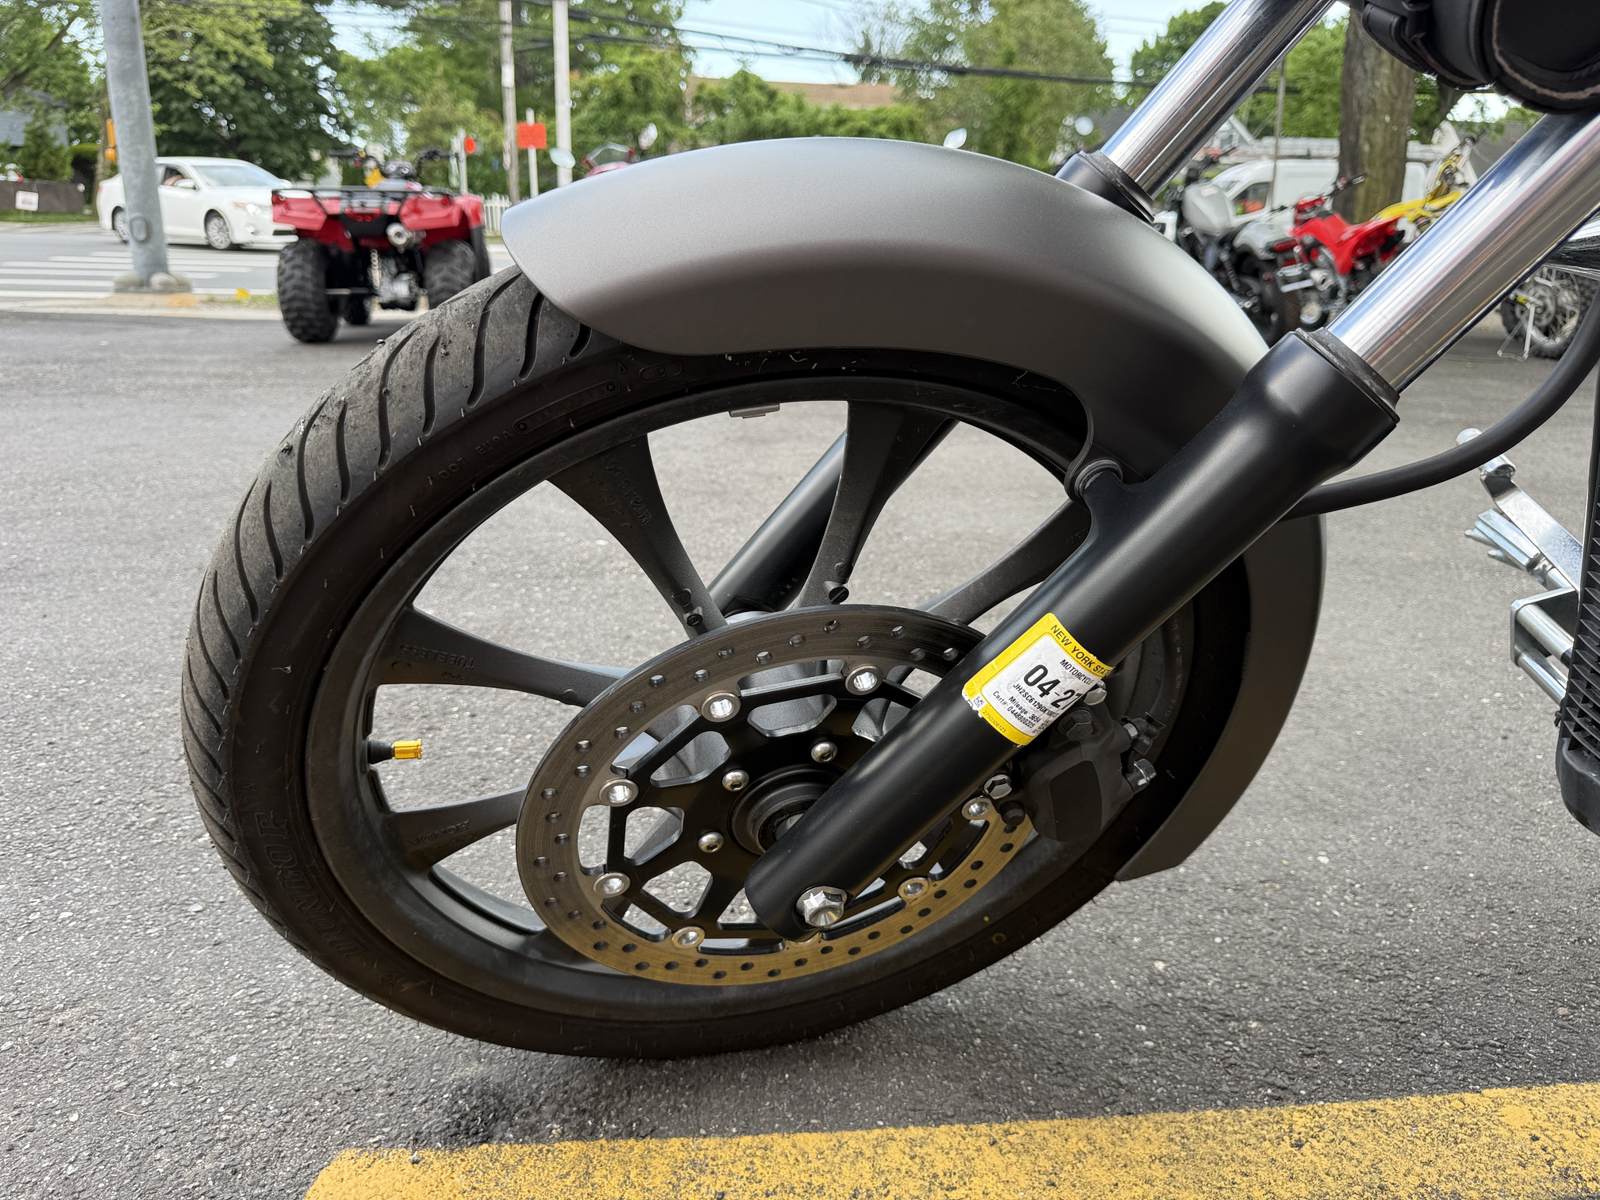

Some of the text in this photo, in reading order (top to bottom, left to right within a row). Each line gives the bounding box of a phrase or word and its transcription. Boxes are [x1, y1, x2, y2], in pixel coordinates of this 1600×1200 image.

[438, 457, 468, 481] DOT
[400, 644, 475, 671] TUBELESS
[1051, 624, 1072, 647] NEW
[1071, 646, 1095, 669] YORK
